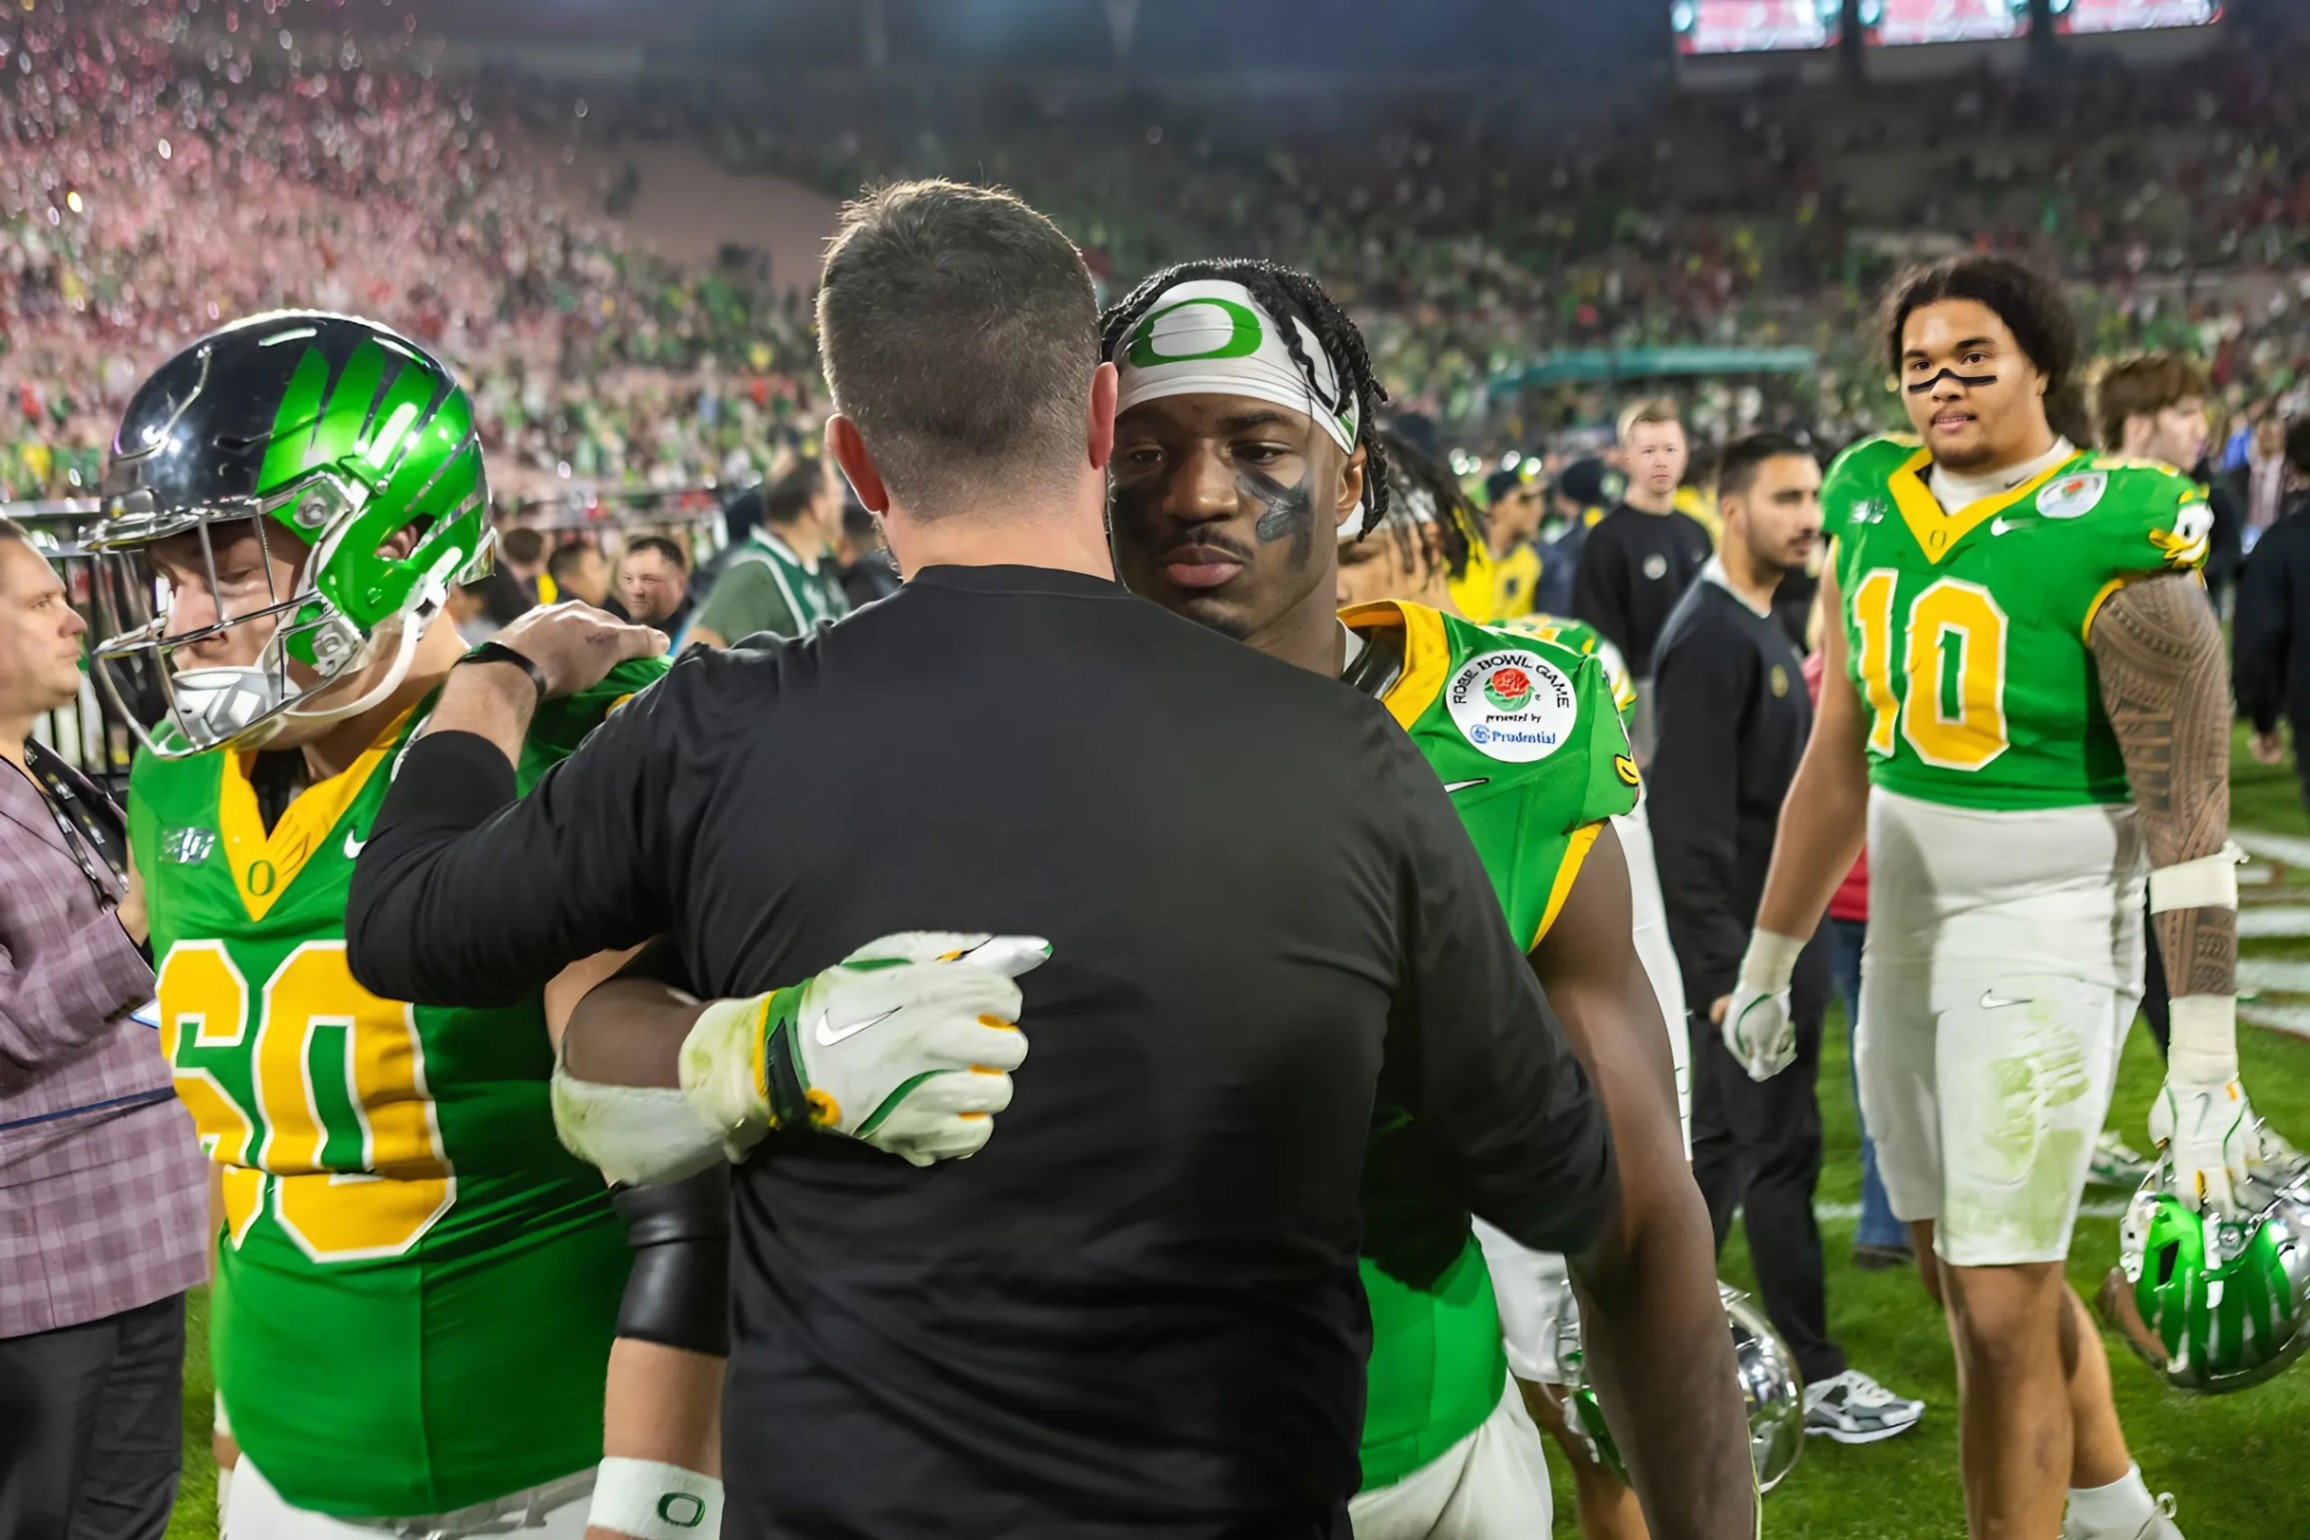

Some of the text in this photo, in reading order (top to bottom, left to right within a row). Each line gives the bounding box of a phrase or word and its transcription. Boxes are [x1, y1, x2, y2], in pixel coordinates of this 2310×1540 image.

[1477, 654, 1532, 670] BOWL
[1535, 665, 1570, 708] GAME
[1853, 567, 2010, 772] 10
[1531, 713, 1541, 723] by
[1491, 731, 1556, 744] Prudential
[247, 859, 276, 896] O
[154, 939, 456, 1263] 60
[657, 1492, 705, 1528] O
